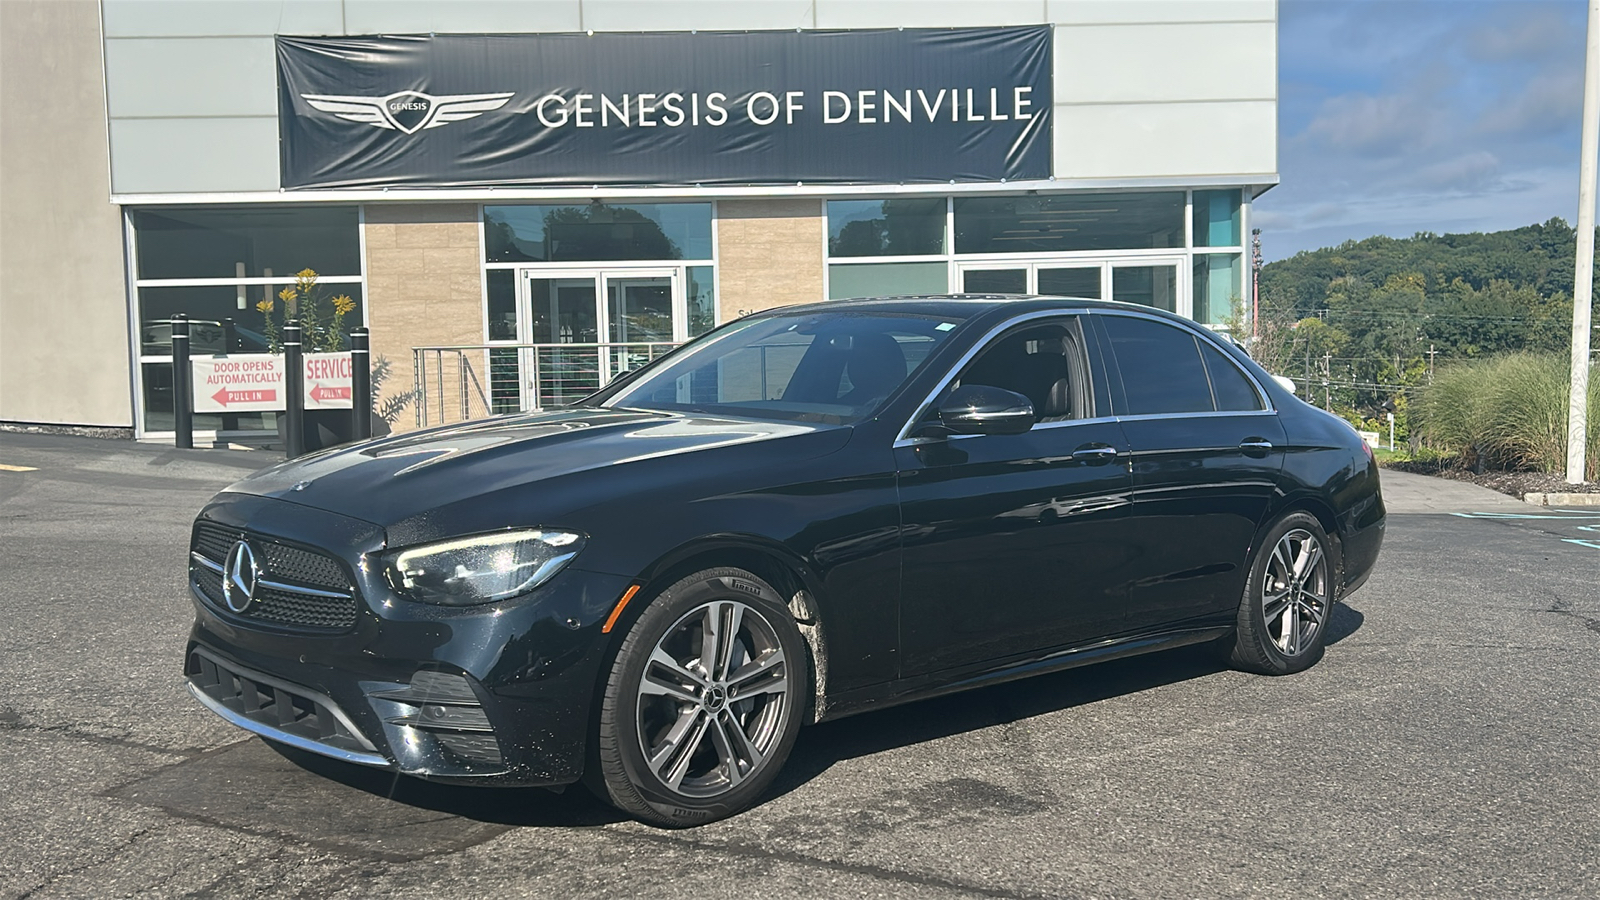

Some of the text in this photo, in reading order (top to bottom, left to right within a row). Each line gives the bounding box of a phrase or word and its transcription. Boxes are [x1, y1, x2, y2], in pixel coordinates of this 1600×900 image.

[389, 101, 427, 111] GENESIS
[536, 85, 1034, 128] GENESIS OF DENVILLE
[214, 361, 274, 373] DOOR OPENS
[307, 358, 352, 379] SERVICE
[207, 372, 282, 385] AUTOMATICALLY
[228, 391, 262, 401] PULL IN
[320, 389, 334, 398] PULL
[731, 579, 761, 595] PIRELLI
